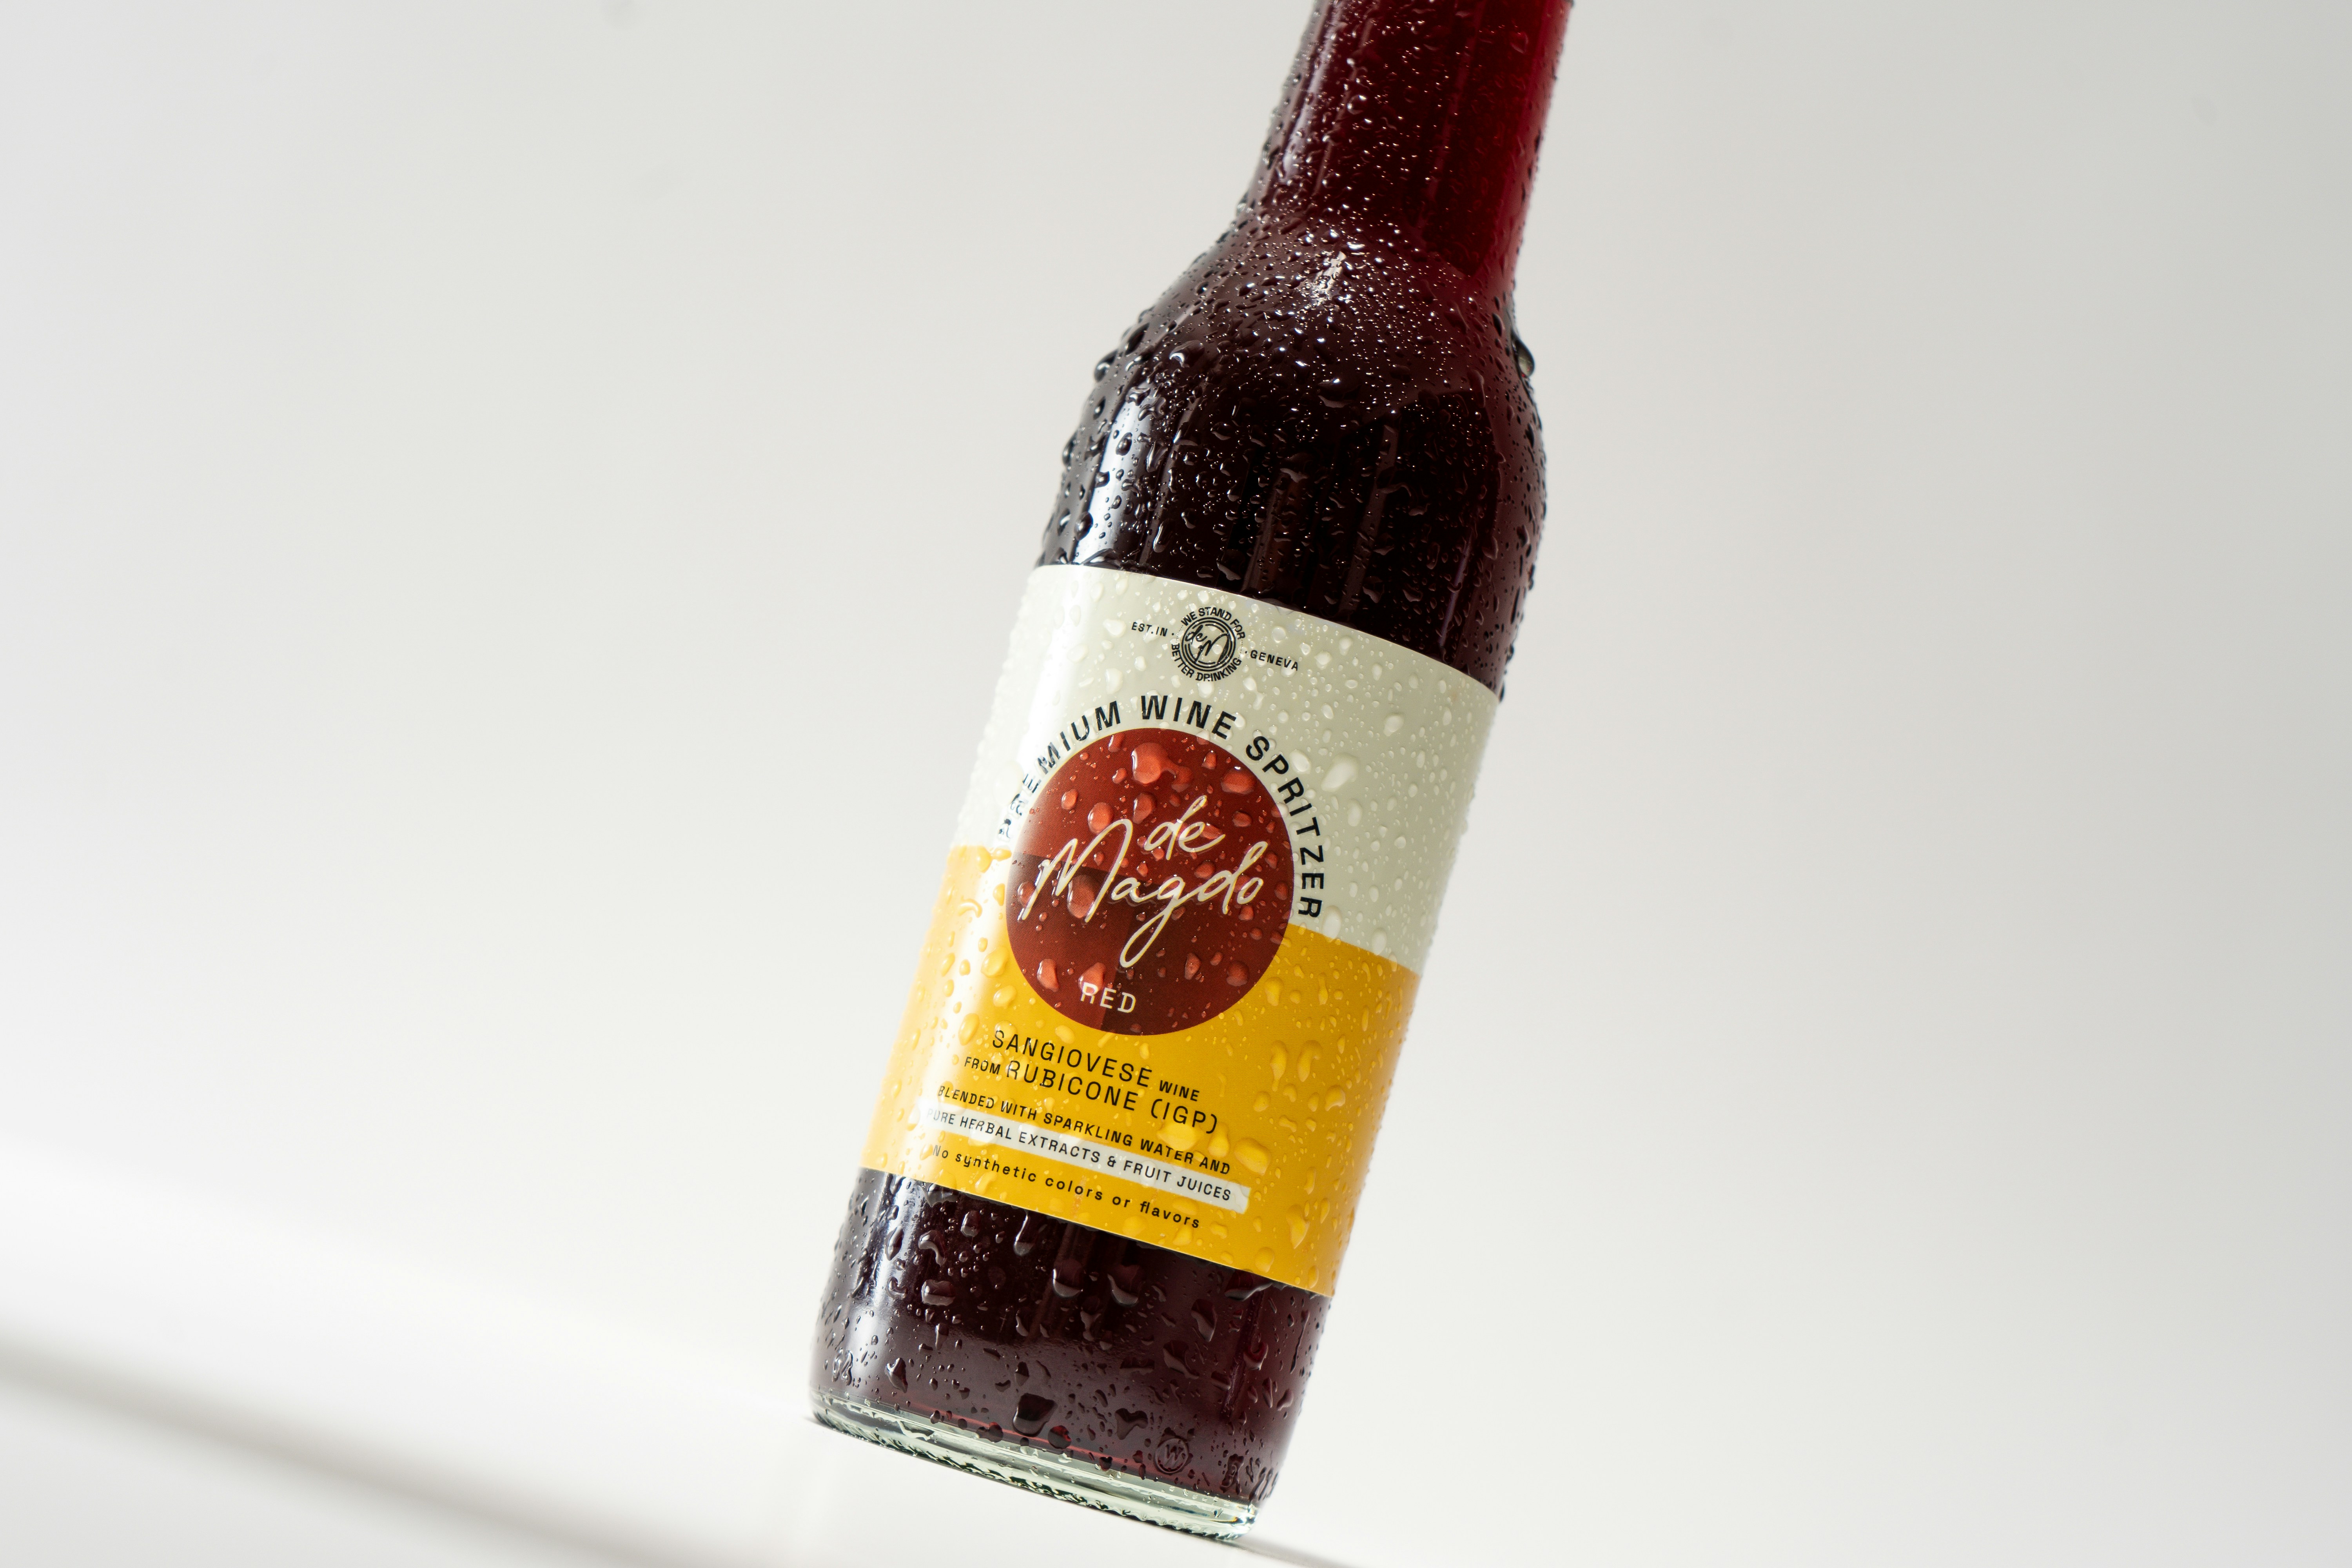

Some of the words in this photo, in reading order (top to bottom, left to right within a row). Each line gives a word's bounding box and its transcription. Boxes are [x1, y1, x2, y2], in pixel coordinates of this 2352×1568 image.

[1181, 612, 1197, 626] WE
[1198, 607, 1232, 621] STAND
[1230, 619, 1245, 639] FOR
[1171, 643, 1194, 678] BETTER
[1196, 658, 1242, 681] DRINKING
[1250, 650, 1298, 671] GENEVA
[1142, 695, 1237, 739] WINE
[1246, 735, 1324, 918] SPRITZER
[1144, 795, 1225, 860] de
[1018, 818, 1268, 967] Magdo
[1081, 982, 1136, 1013] RED
[964, 1057, 1001, 1075] FROM
[1006, 1060, 1138, 1111] RUBICONE
[1151, 1098, 1218, 1134] (IGP)
[992, 1030, 1152, 1087] SANGIOVESE
[1159, 1080, 1200, 1102] WINE
[927, 1109, 956, 1124] PURE
[960, 1116, 1012, 1140] HERBAL
[1019, 1132, 1100, 1163] EXTRACTS
[1107, 1156, 1116, 1167] &
[1124, 1160, 1172, 1183] FRUIT
[1177, 1175, 1231, 1201] JUICES
[938, 1086, 994, 1109] BLENDED
[1001, 1100, 1037, 1121] WITH
[1044, 1112, 1133, 1147] SPARKLING
[1140, 1139, 1195, 1163] WATER
[1199, 1157, 1230, 1175] AND
[933, 1145, 948, 1158] No
[955, 1154, 1036, 1182] synthetic
[1045, 1175, 1102, 1200] colors
[1112, 1196, 1130, 1208] or
[1140, 1201, 1200, 1229] flavors
